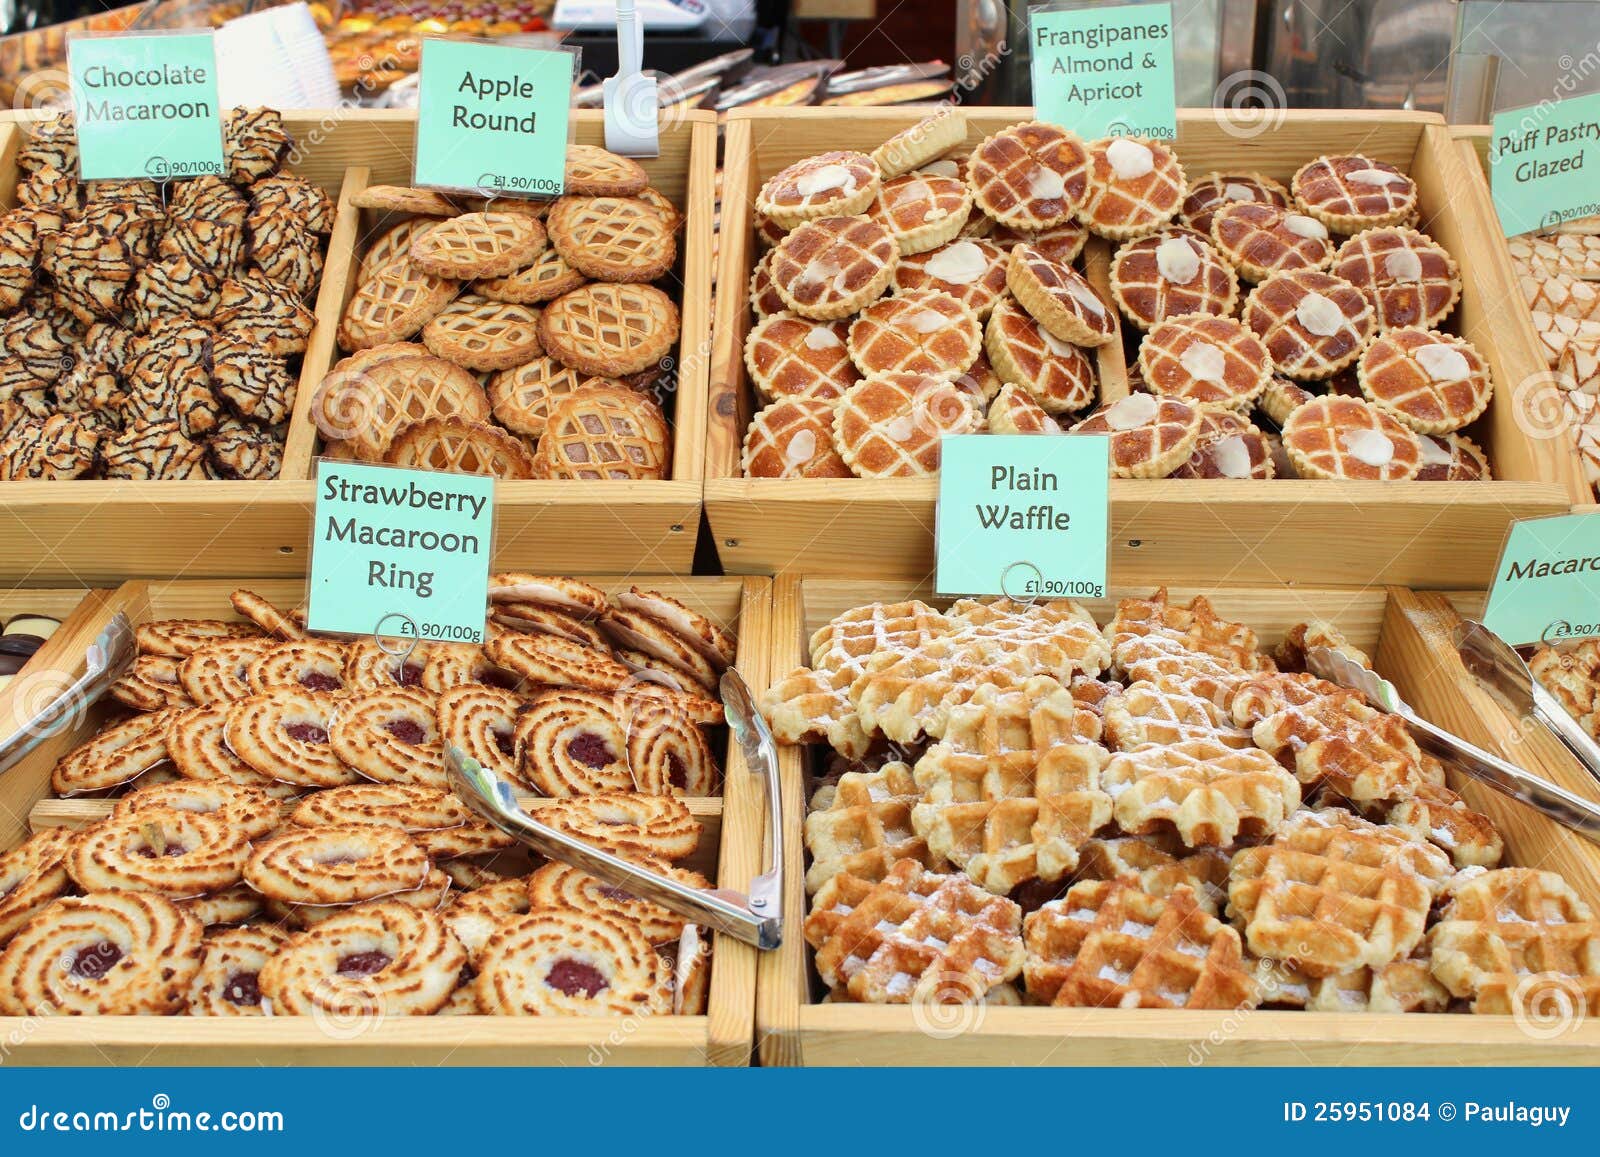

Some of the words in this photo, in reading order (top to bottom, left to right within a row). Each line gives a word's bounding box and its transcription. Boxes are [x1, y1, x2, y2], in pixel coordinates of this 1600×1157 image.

[1037, 23, 1168, 49] Frangipanes
[84, 63, 206, 89] Chocolate
[1052, 52, 1133, 74] Almond
[1142, 52, 1157, 69] &
[458, 71, 534, 100] Apple
[1067, 81, 1142, 104] Apricot
[85, 99, 210, 121] Macaroon
[452, 105, 536, 135] Round
[1499, 129, 1540, 156] Puff
[1515, 149, 1584, 182] Glazed
[990, 465, 1058, 491] Plain
[323, 474, 487, 519] Strawberry
[975, 504, 1071, 532] Waffle
[324, 516, 480, 554] Macaroon
[367, 560, 434, 598] Ring
[1025, 580, 1103, 597] £1.90/100g
